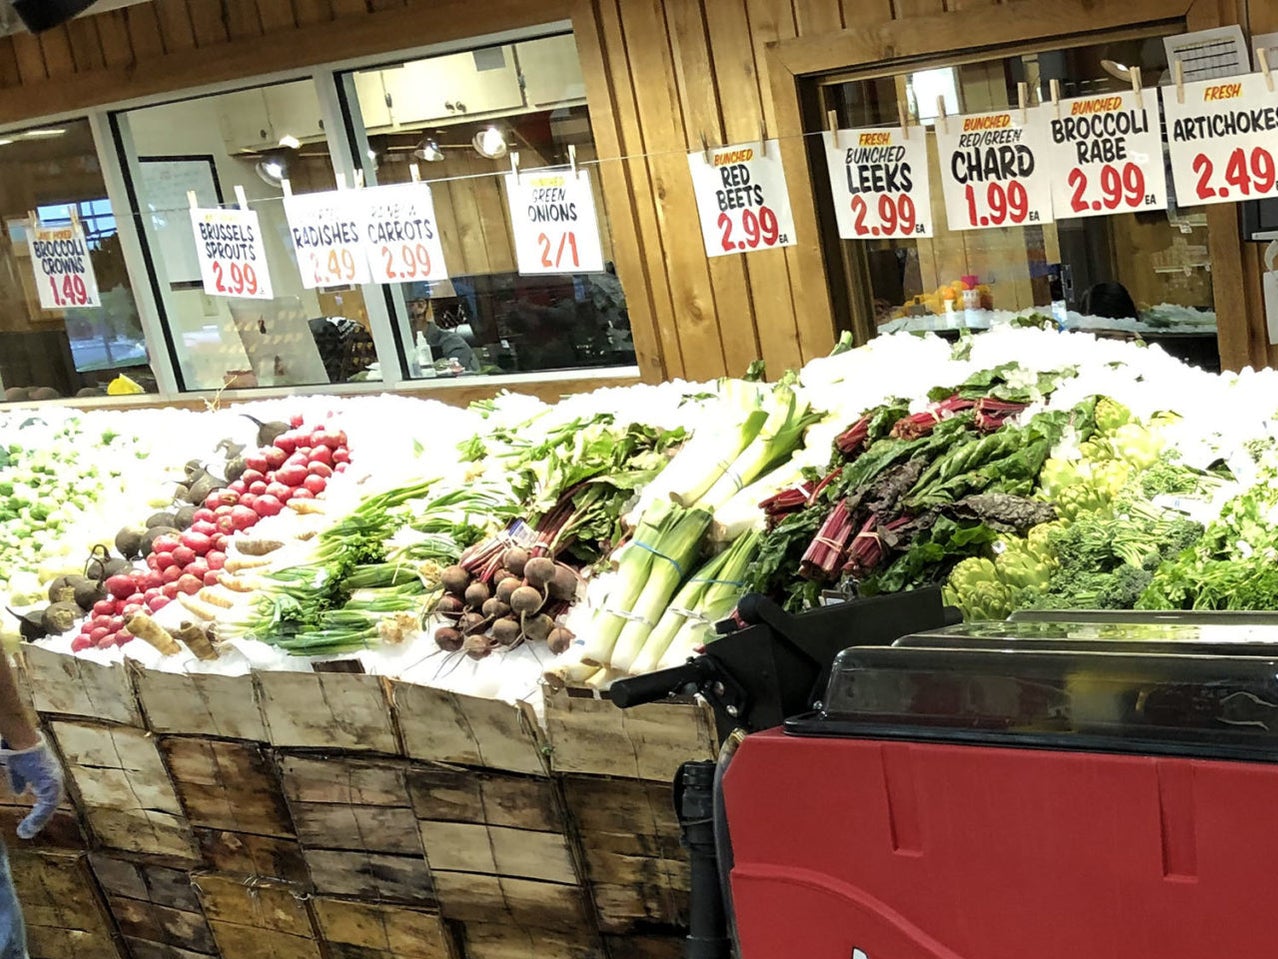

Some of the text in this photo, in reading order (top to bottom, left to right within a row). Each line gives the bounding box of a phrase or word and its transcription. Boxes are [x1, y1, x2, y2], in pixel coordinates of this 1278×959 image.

[1071, 96, 1122, 116] BUNCHED
[1203, 83, 1242, 102] FRESH
[963, 114, 1011, 132] BUNCHED
[1050, 108, 1149, 144] BROCCOLI
[859, 132, 891, 146] FRESH
[959, 129, 1023, 148] RED/GREEN
[1076, 137, 1127, 165] RABE
[714, 148, 754, 166] BUNCHED
[846, 146, 906, 164] BUNCHED
[951, 144, 1035, 184] CHARD
[719, 164, 751, 189] RED
[846, 162, 913, 195] LEEKS
[1192, 146, 1276, 200] 2.49
[532, 188, 566, 203] GREEN
[715, 184, 764, 212] BEETS
[1068, 162, 1156, 213] 2.99 EA
[528, 202, 578, 223] ONIONS
[851, 193, 926, 236] 2.99 EA
[965, 180, 1040, 227] 1.99 EA
[198, 222, 254, 242] BRUSSELS
[292, 221, 359, 249] RADISHES
[367, 219, 434, 244] CARROTS
[717, 205, 789, 252] 2.99 EA
[32, 239, 85, 258] BROCCOLI
[205, 241, 256, 261] SPROUTS
[381, 243, 431, 279] 2.99
[538, 231, 580, 268] 2/1
[41, 256, 85, 275] CROWNS
[212, 260, 258, 295] 2.99
[310, 248, 355, 284] 2.49
[49, 273, 88, 306] 1.49
